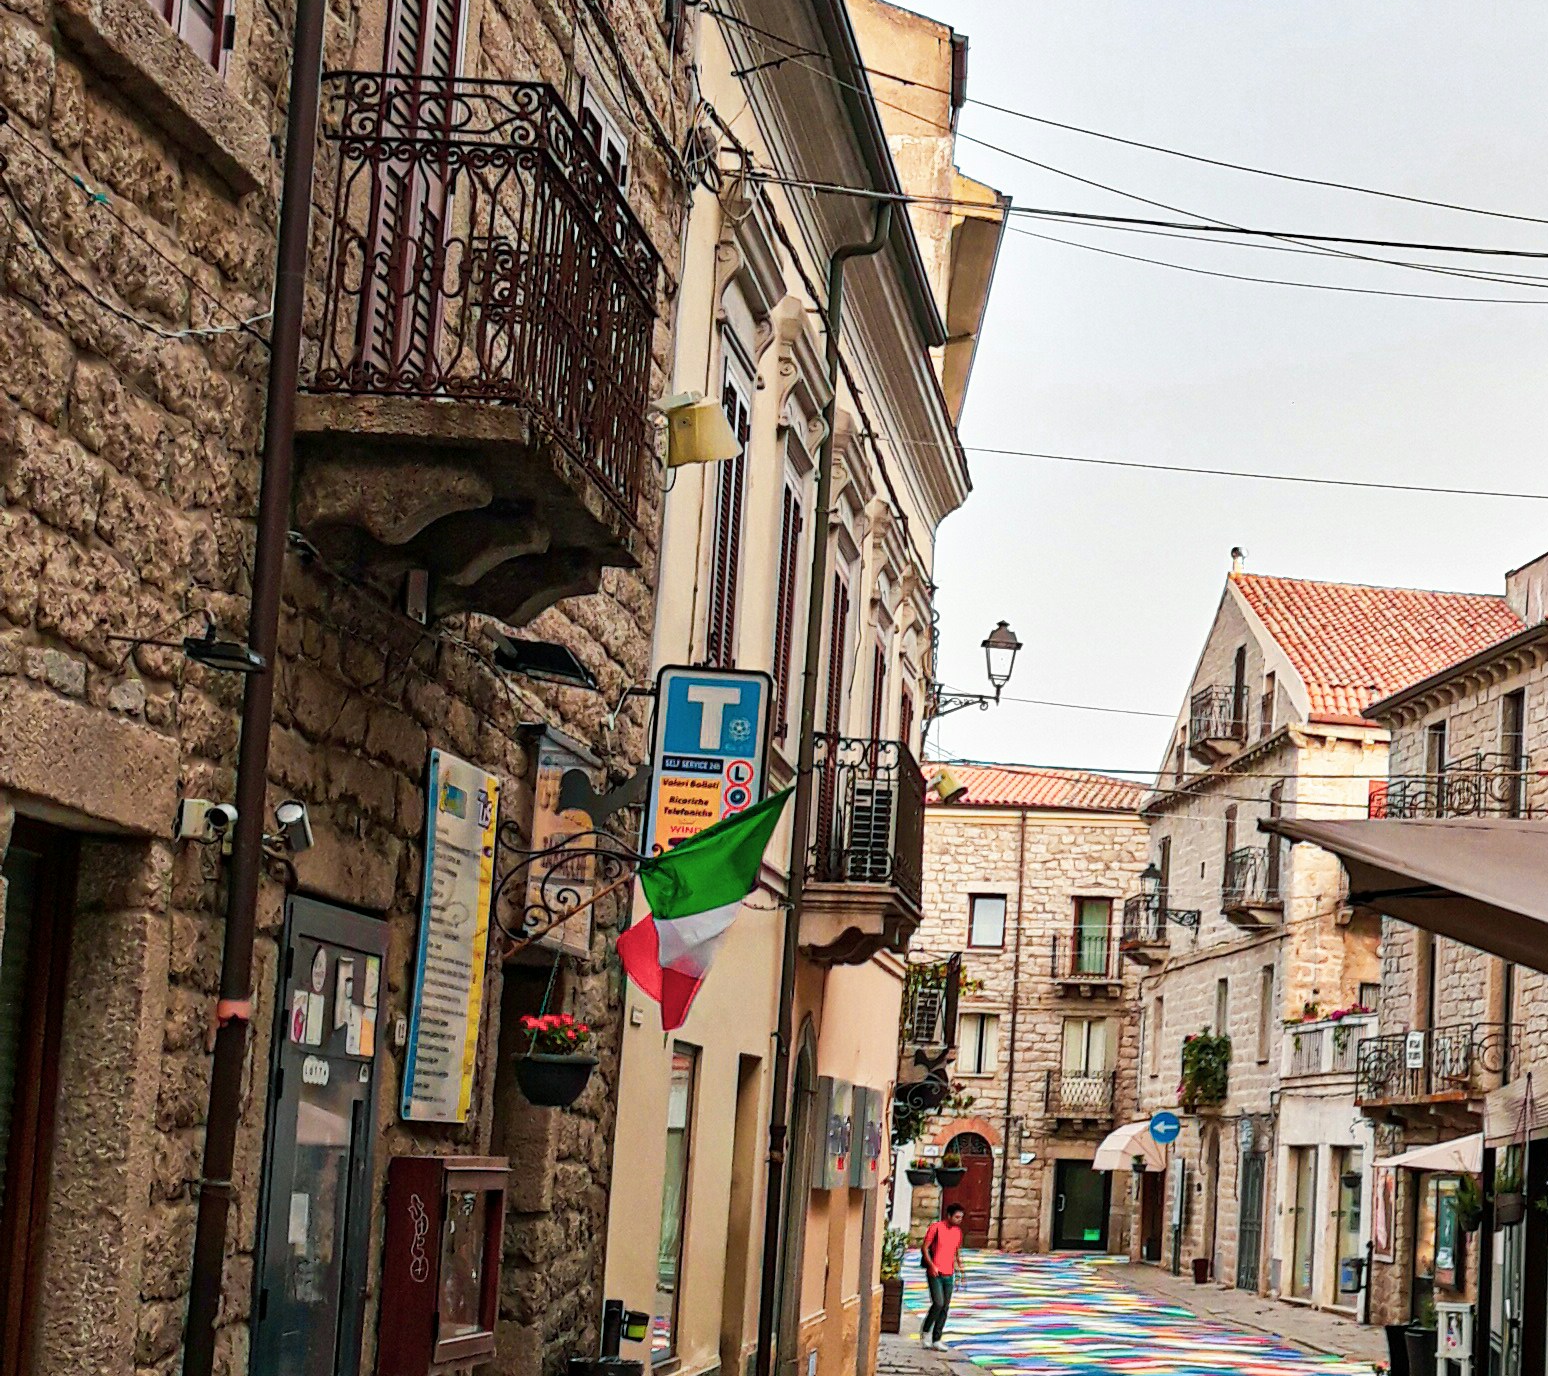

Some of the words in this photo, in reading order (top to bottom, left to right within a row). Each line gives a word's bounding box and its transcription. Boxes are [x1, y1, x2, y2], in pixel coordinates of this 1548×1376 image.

[687, 684, 741, 750] T
[665, 757, 680, 768] SELF
[682, 759, 708, 770] SERVICE
